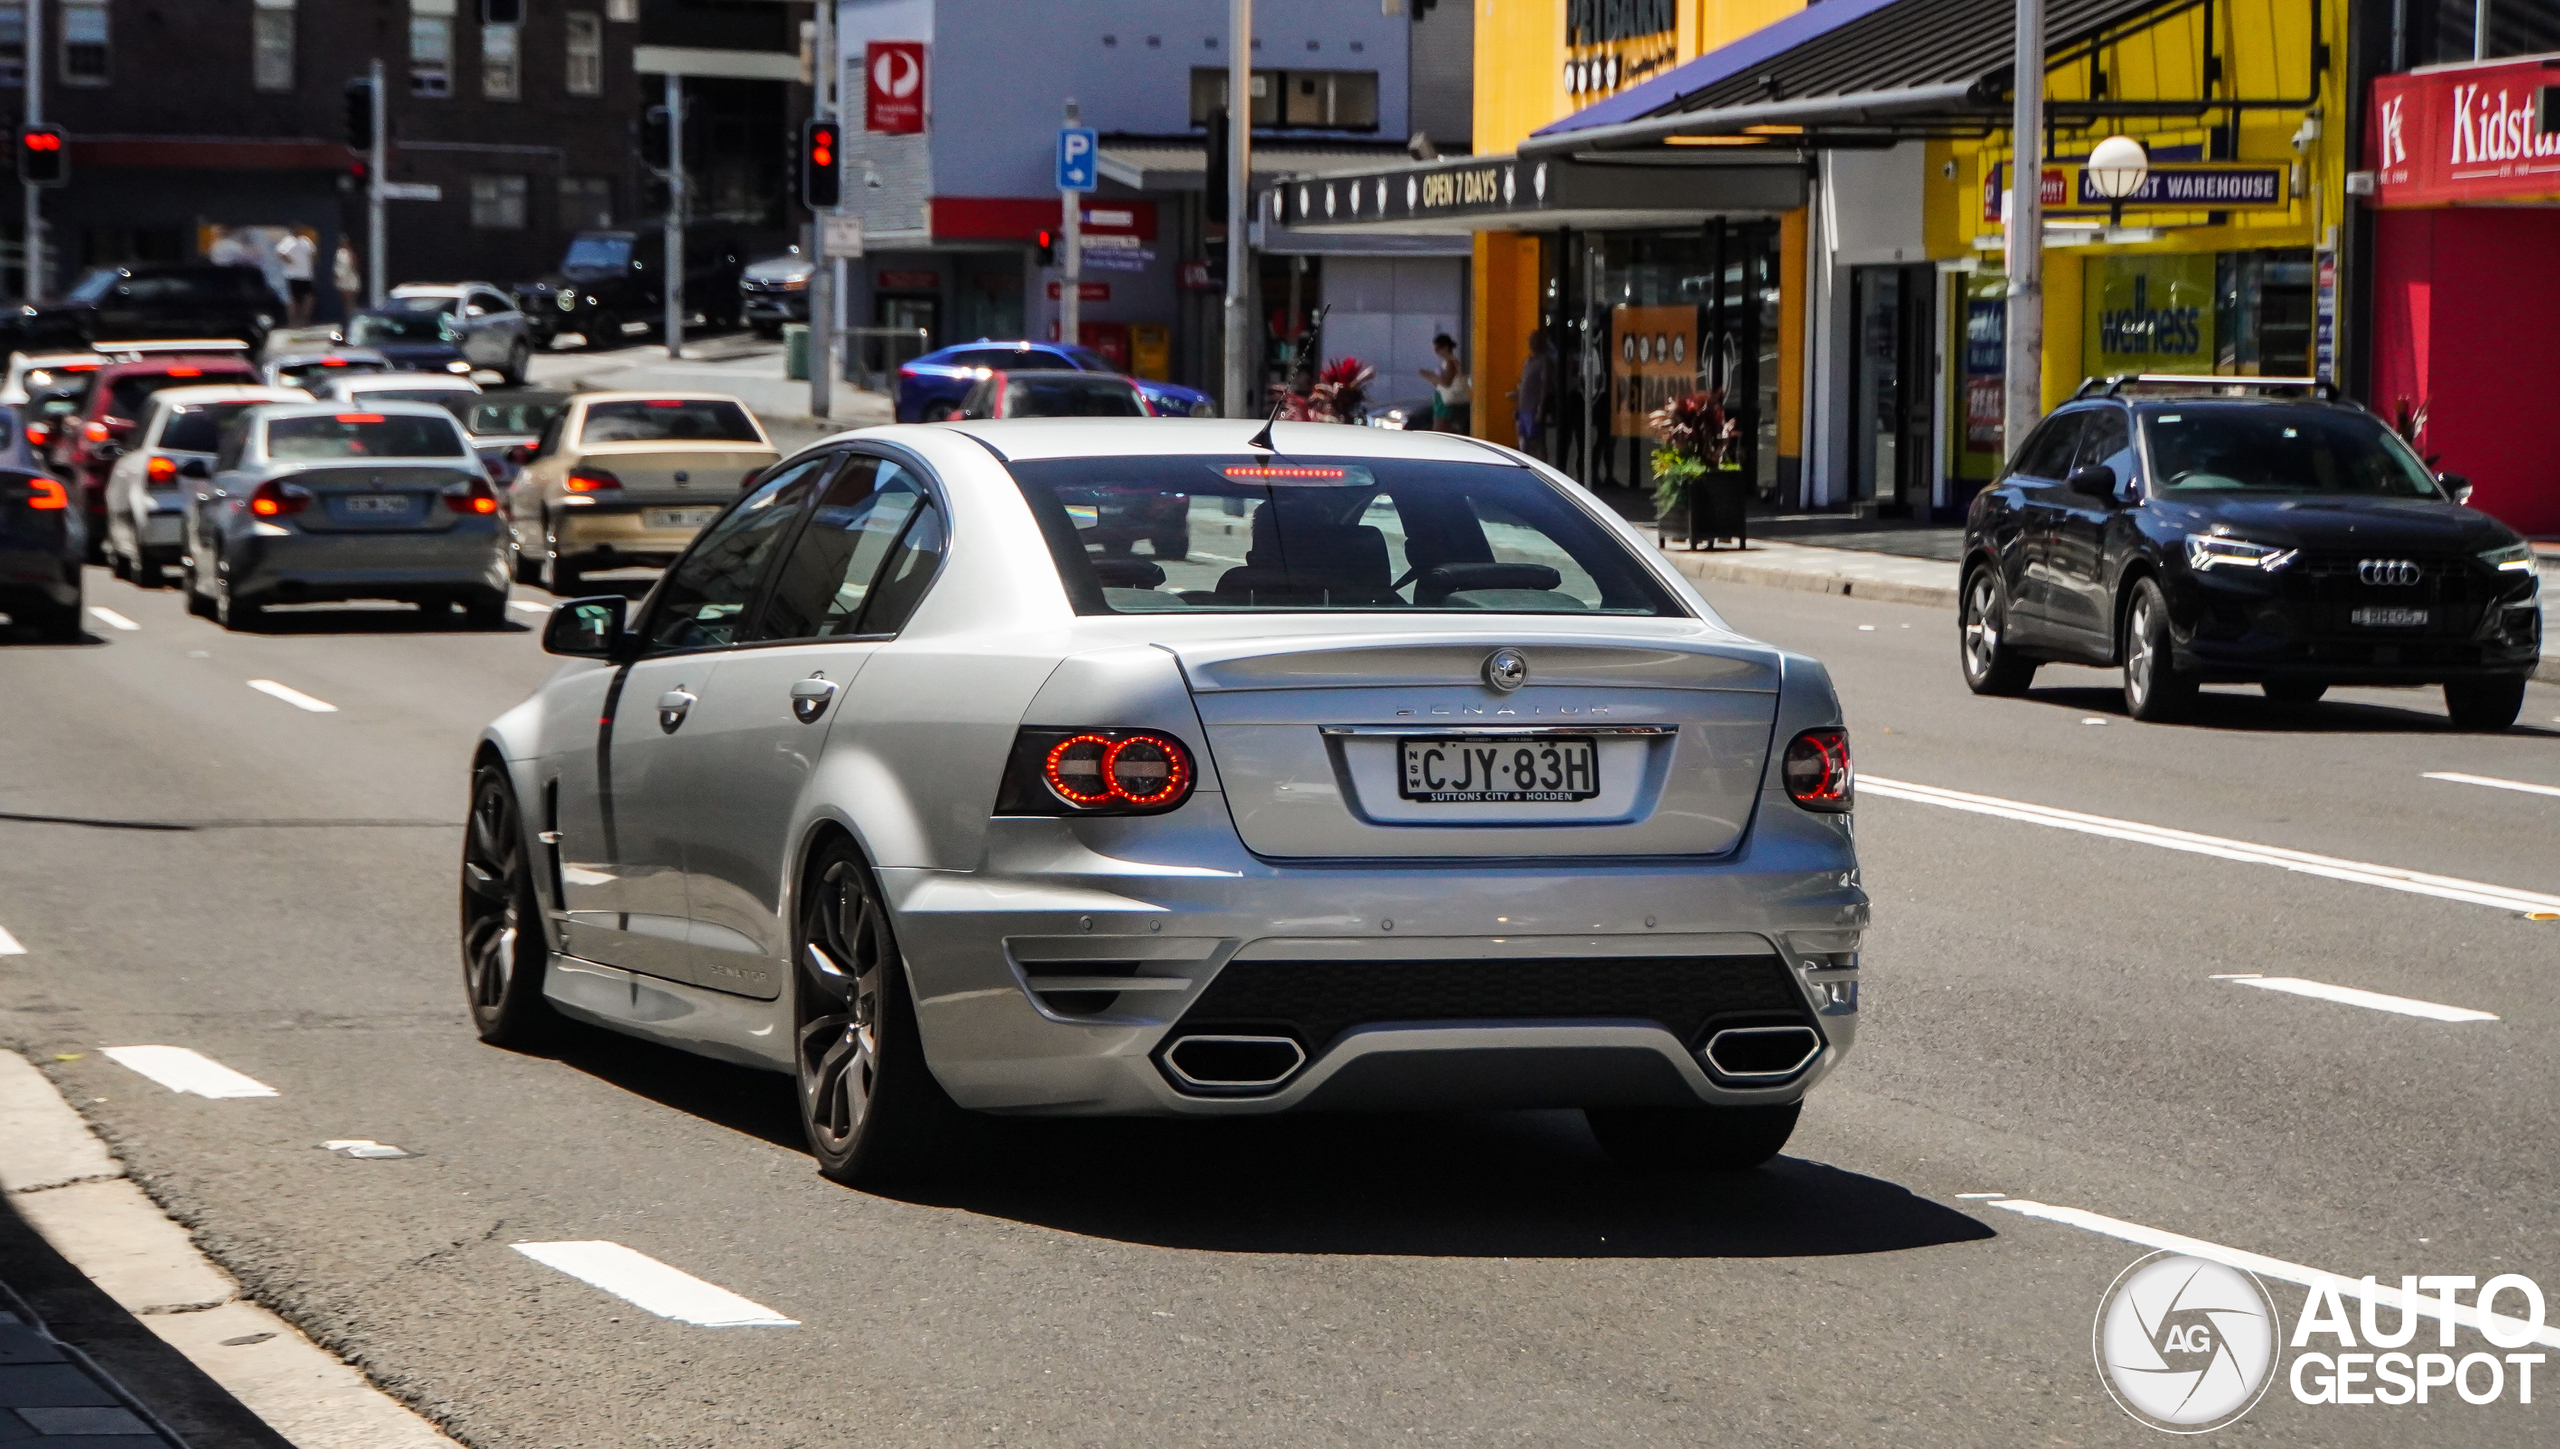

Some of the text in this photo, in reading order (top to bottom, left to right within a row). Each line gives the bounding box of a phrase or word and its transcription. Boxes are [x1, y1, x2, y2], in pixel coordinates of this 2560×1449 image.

[1065, 134, 1090, 165] P
[1423, 169, 1497, 208] OPEN 7 DAYS
[2167, 176, 2274, 198] WAREHOUSE
[2099, 275, 2199, 353] wellness
[1396, 703, 1609, 716] SENATOR
[1431, 792, 1573, 801] SUTTONS CITY HOLDEN
